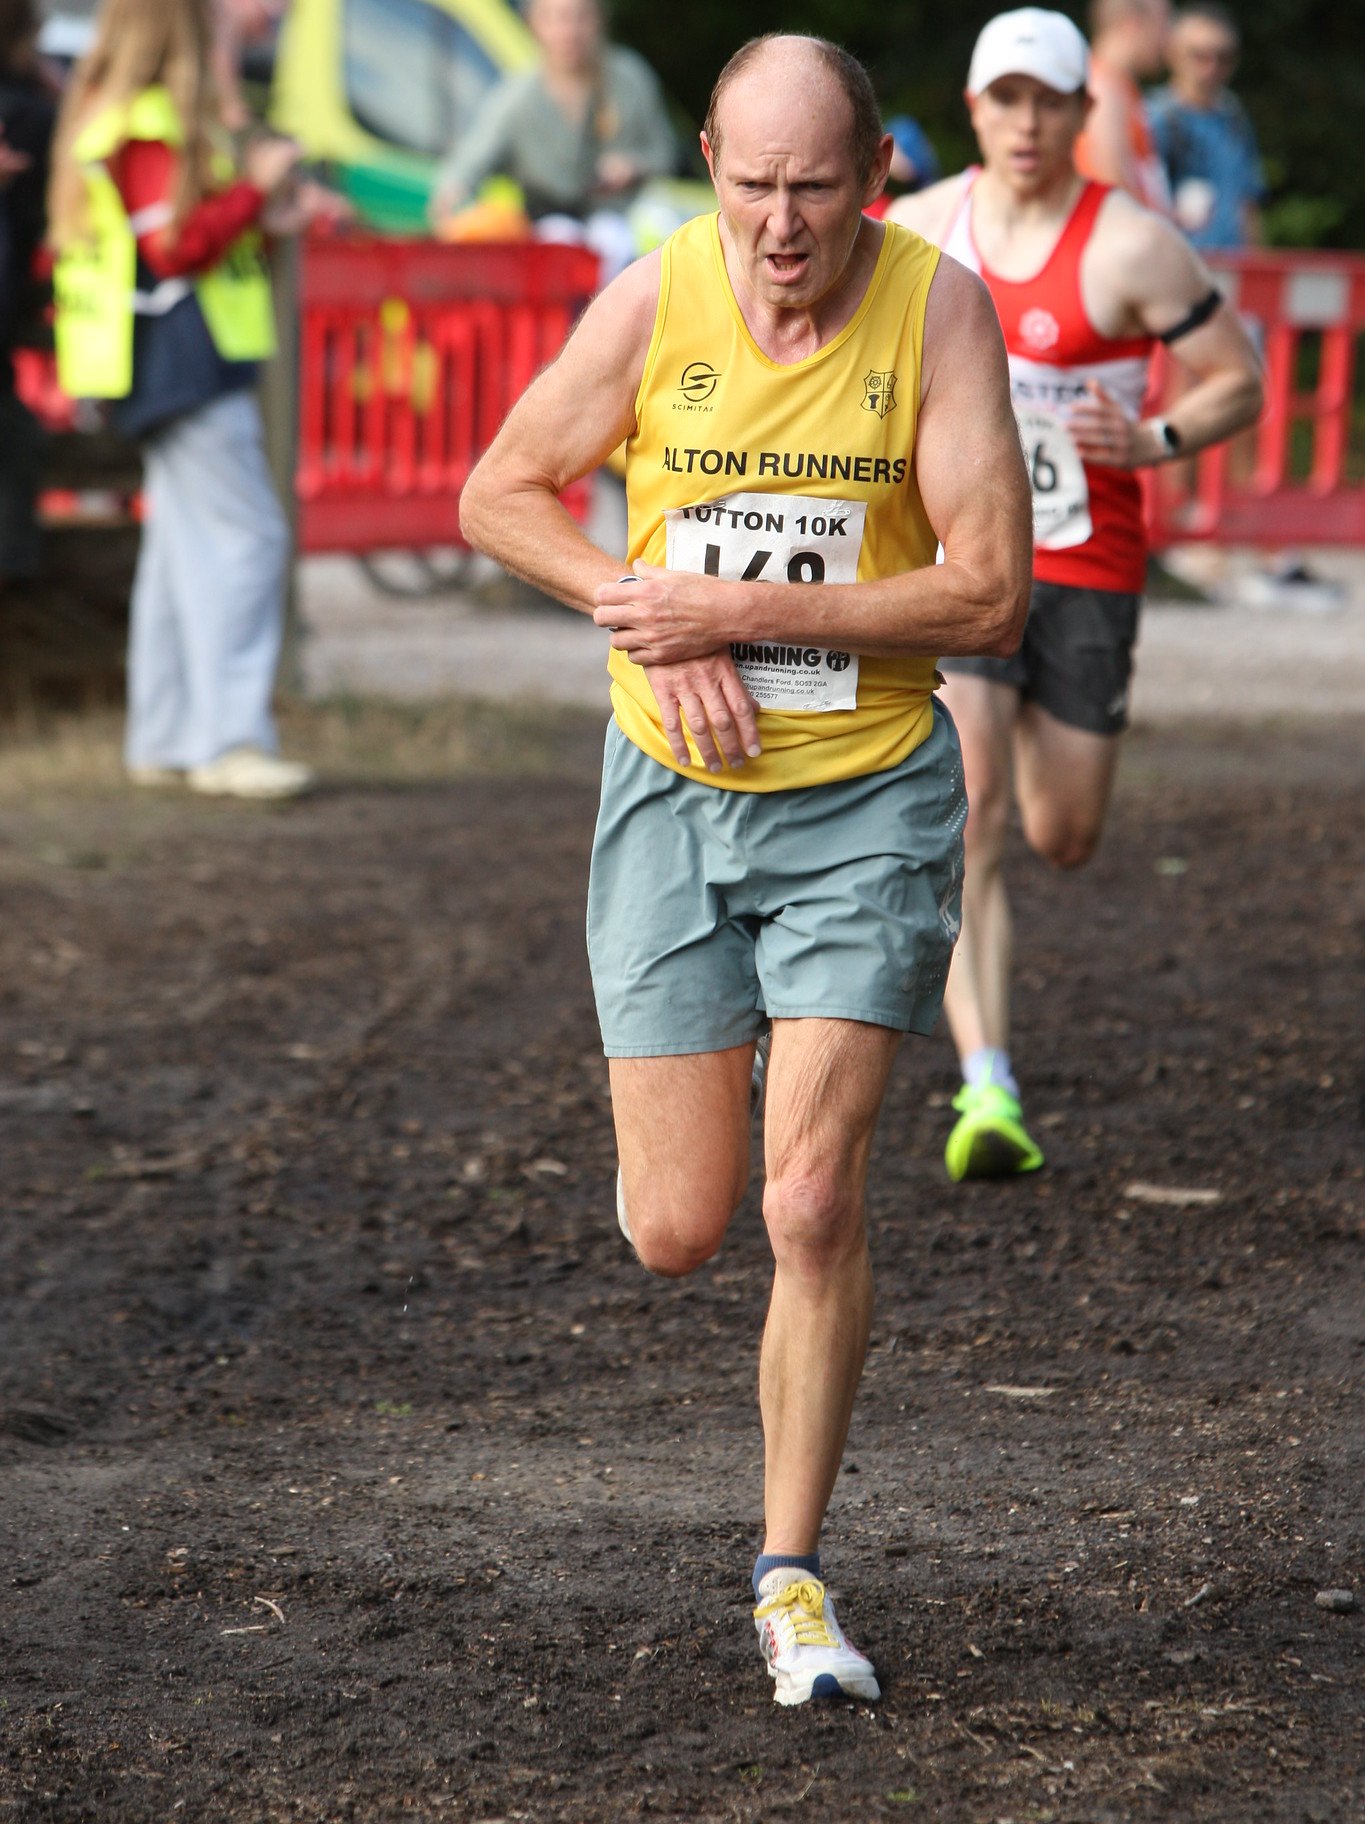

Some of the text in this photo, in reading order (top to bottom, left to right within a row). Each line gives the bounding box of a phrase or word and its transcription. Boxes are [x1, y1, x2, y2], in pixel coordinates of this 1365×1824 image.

[662, 446, 908, 484] ALTON RUNNERS
[795, 515, 848, 537] 10K
[741, 674, 774, 684] Chandlers
